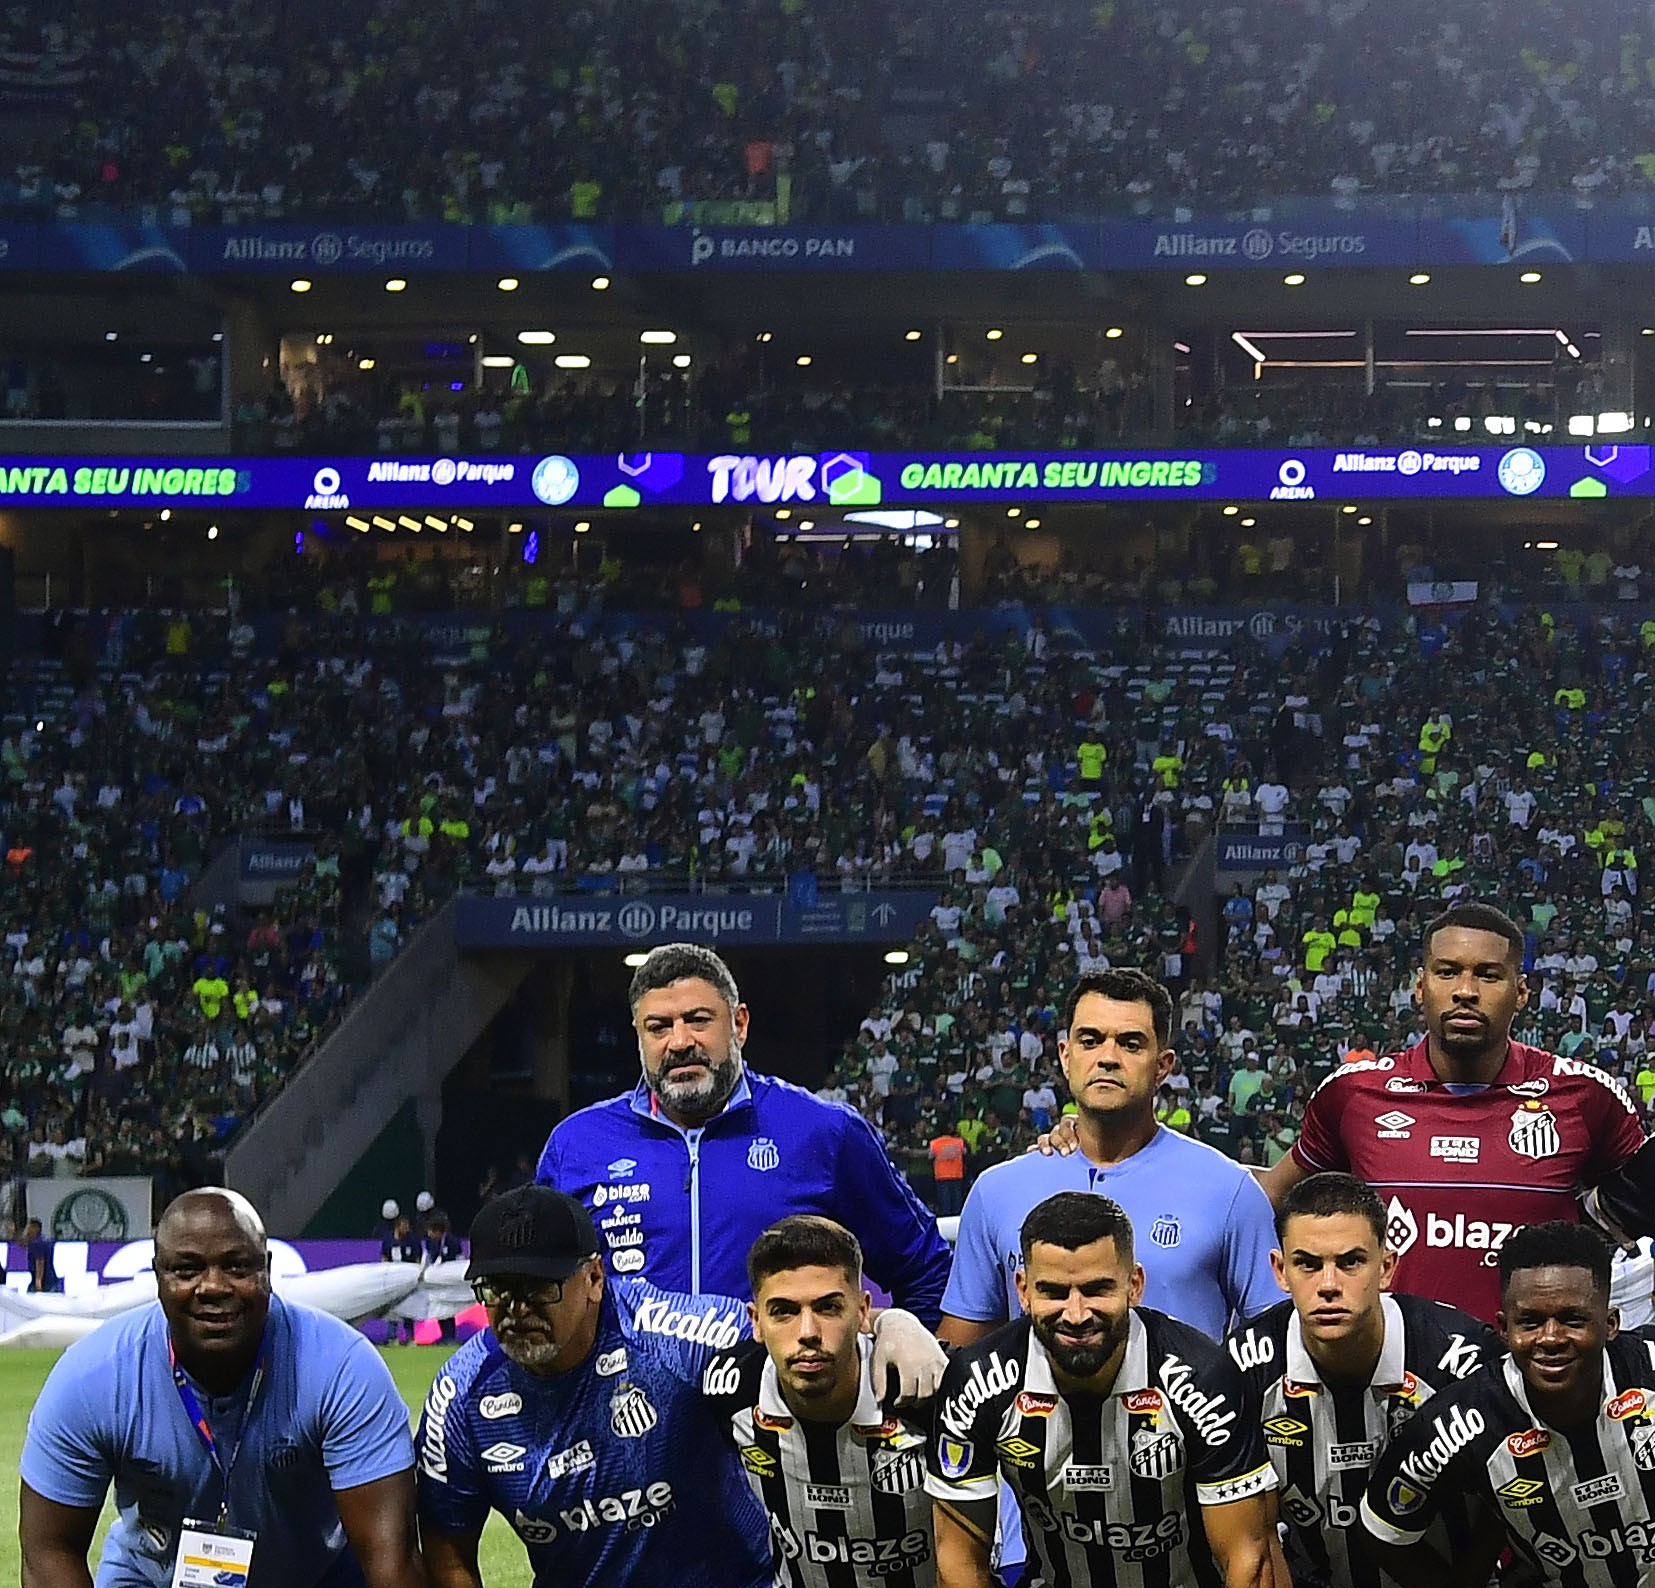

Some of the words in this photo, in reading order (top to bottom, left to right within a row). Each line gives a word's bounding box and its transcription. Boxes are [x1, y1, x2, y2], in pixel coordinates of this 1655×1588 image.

[223, 238, 306, 261] Allianz
[721, 240, 799, 257] BANCO
[805, 239, 854, 257] PAN
[1154, 235, 1237, 255] Allianz
[1278, 233, 1365, 260] Seguros
[368, 462, 430, 483] Allianz
[457, 464, 514, 485] Parque
[900, 463, 1040, 488] GARANTA
[1044, 461, 1098, 487] SEU
[1333, 453, 1396, 474] Allianz
[1422, 455, 1480, 475] Parque
[74, 469, 132, 495] SEU
[708, 455, 816, 503] TOUR
[1225, 845, 1280, 861] Allianz
[510, 905, 611, 932] Allianz
[660, 905, 752, 936] Parque
[633, 1299, 741, 1349] Kicaldo
[940, 1350, 1020, 1440] Kicaldo
[1159, 1353, 1237, 1447] Kicaldo
[1267, 1435, 1304, 1447] umbro
[1399, 1401, 1486, 1491] Kicaldo
[488, 1461, 524, 1473] umbro
[1066, 1466, 1111, 1477] TEK
[1331, 1453, 1375, 1464] BOND
[1066, 1476, 1111, 1486] BOND
[560, 1482, 672, 1531] blaze
[1065, 1512, 1180, 1549] blaze
[808, 1531, 926, 1563] blaze
